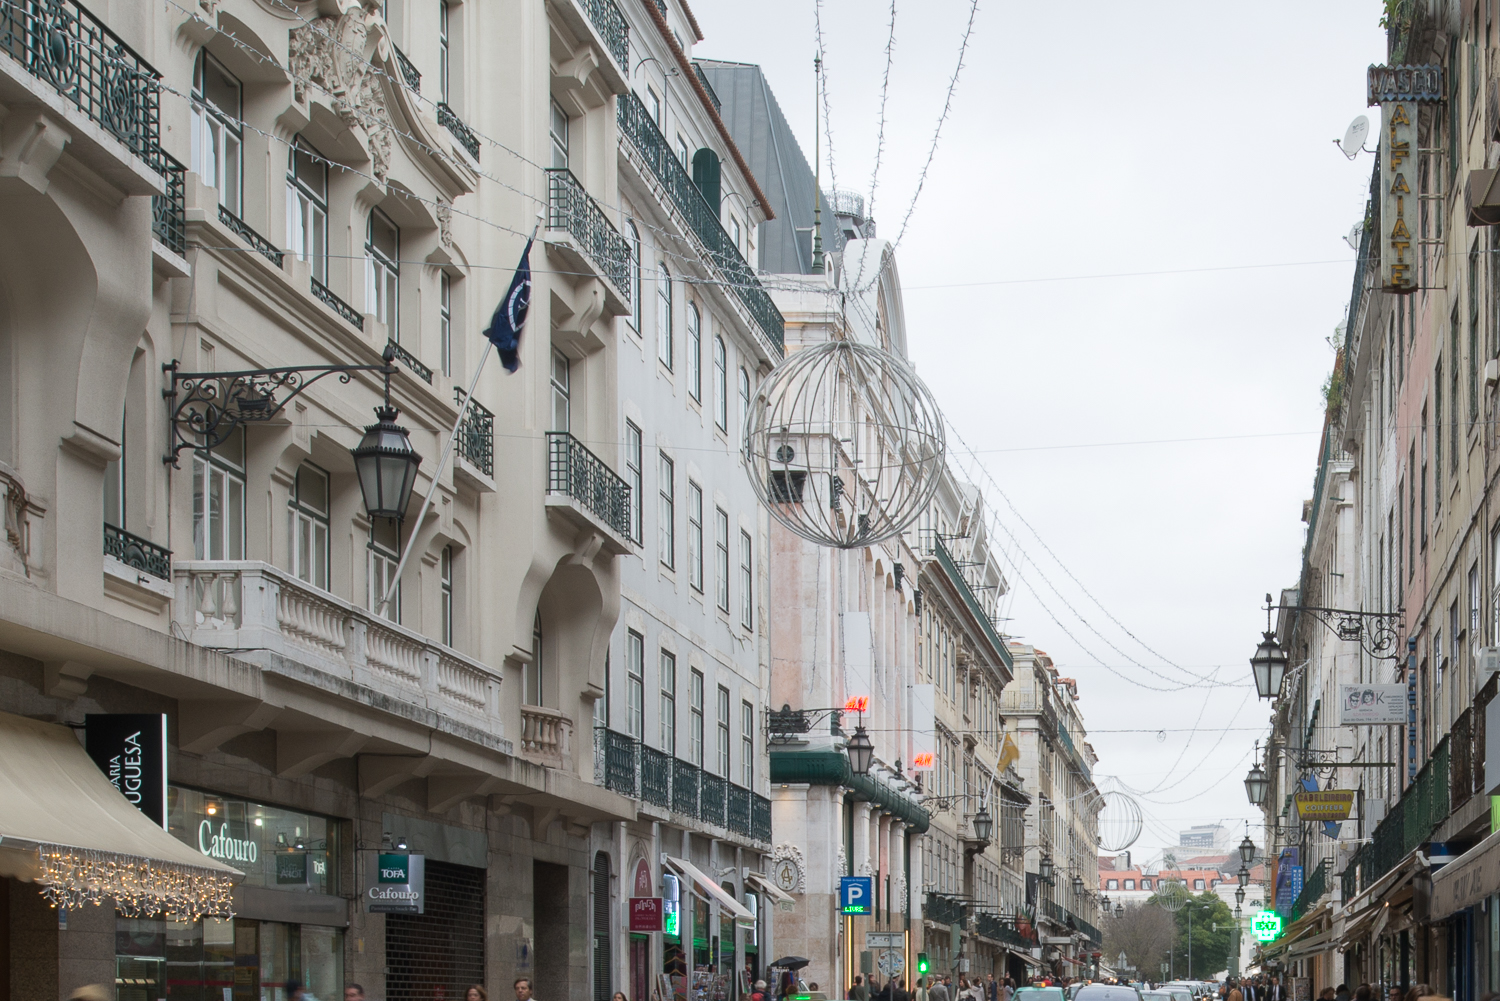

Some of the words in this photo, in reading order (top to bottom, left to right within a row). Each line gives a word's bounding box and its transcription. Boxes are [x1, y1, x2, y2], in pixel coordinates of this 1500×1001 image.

[1390, 105, 1410, 285] ALFAIATE
[125, 731, 142, 811] UGUESA
[198, 820, 257, 862] Cafouro
[381, 869, 405, 878] TOFA
[369, 887, 419, 899] Cafouro
[848, 887, 863, 904] P
